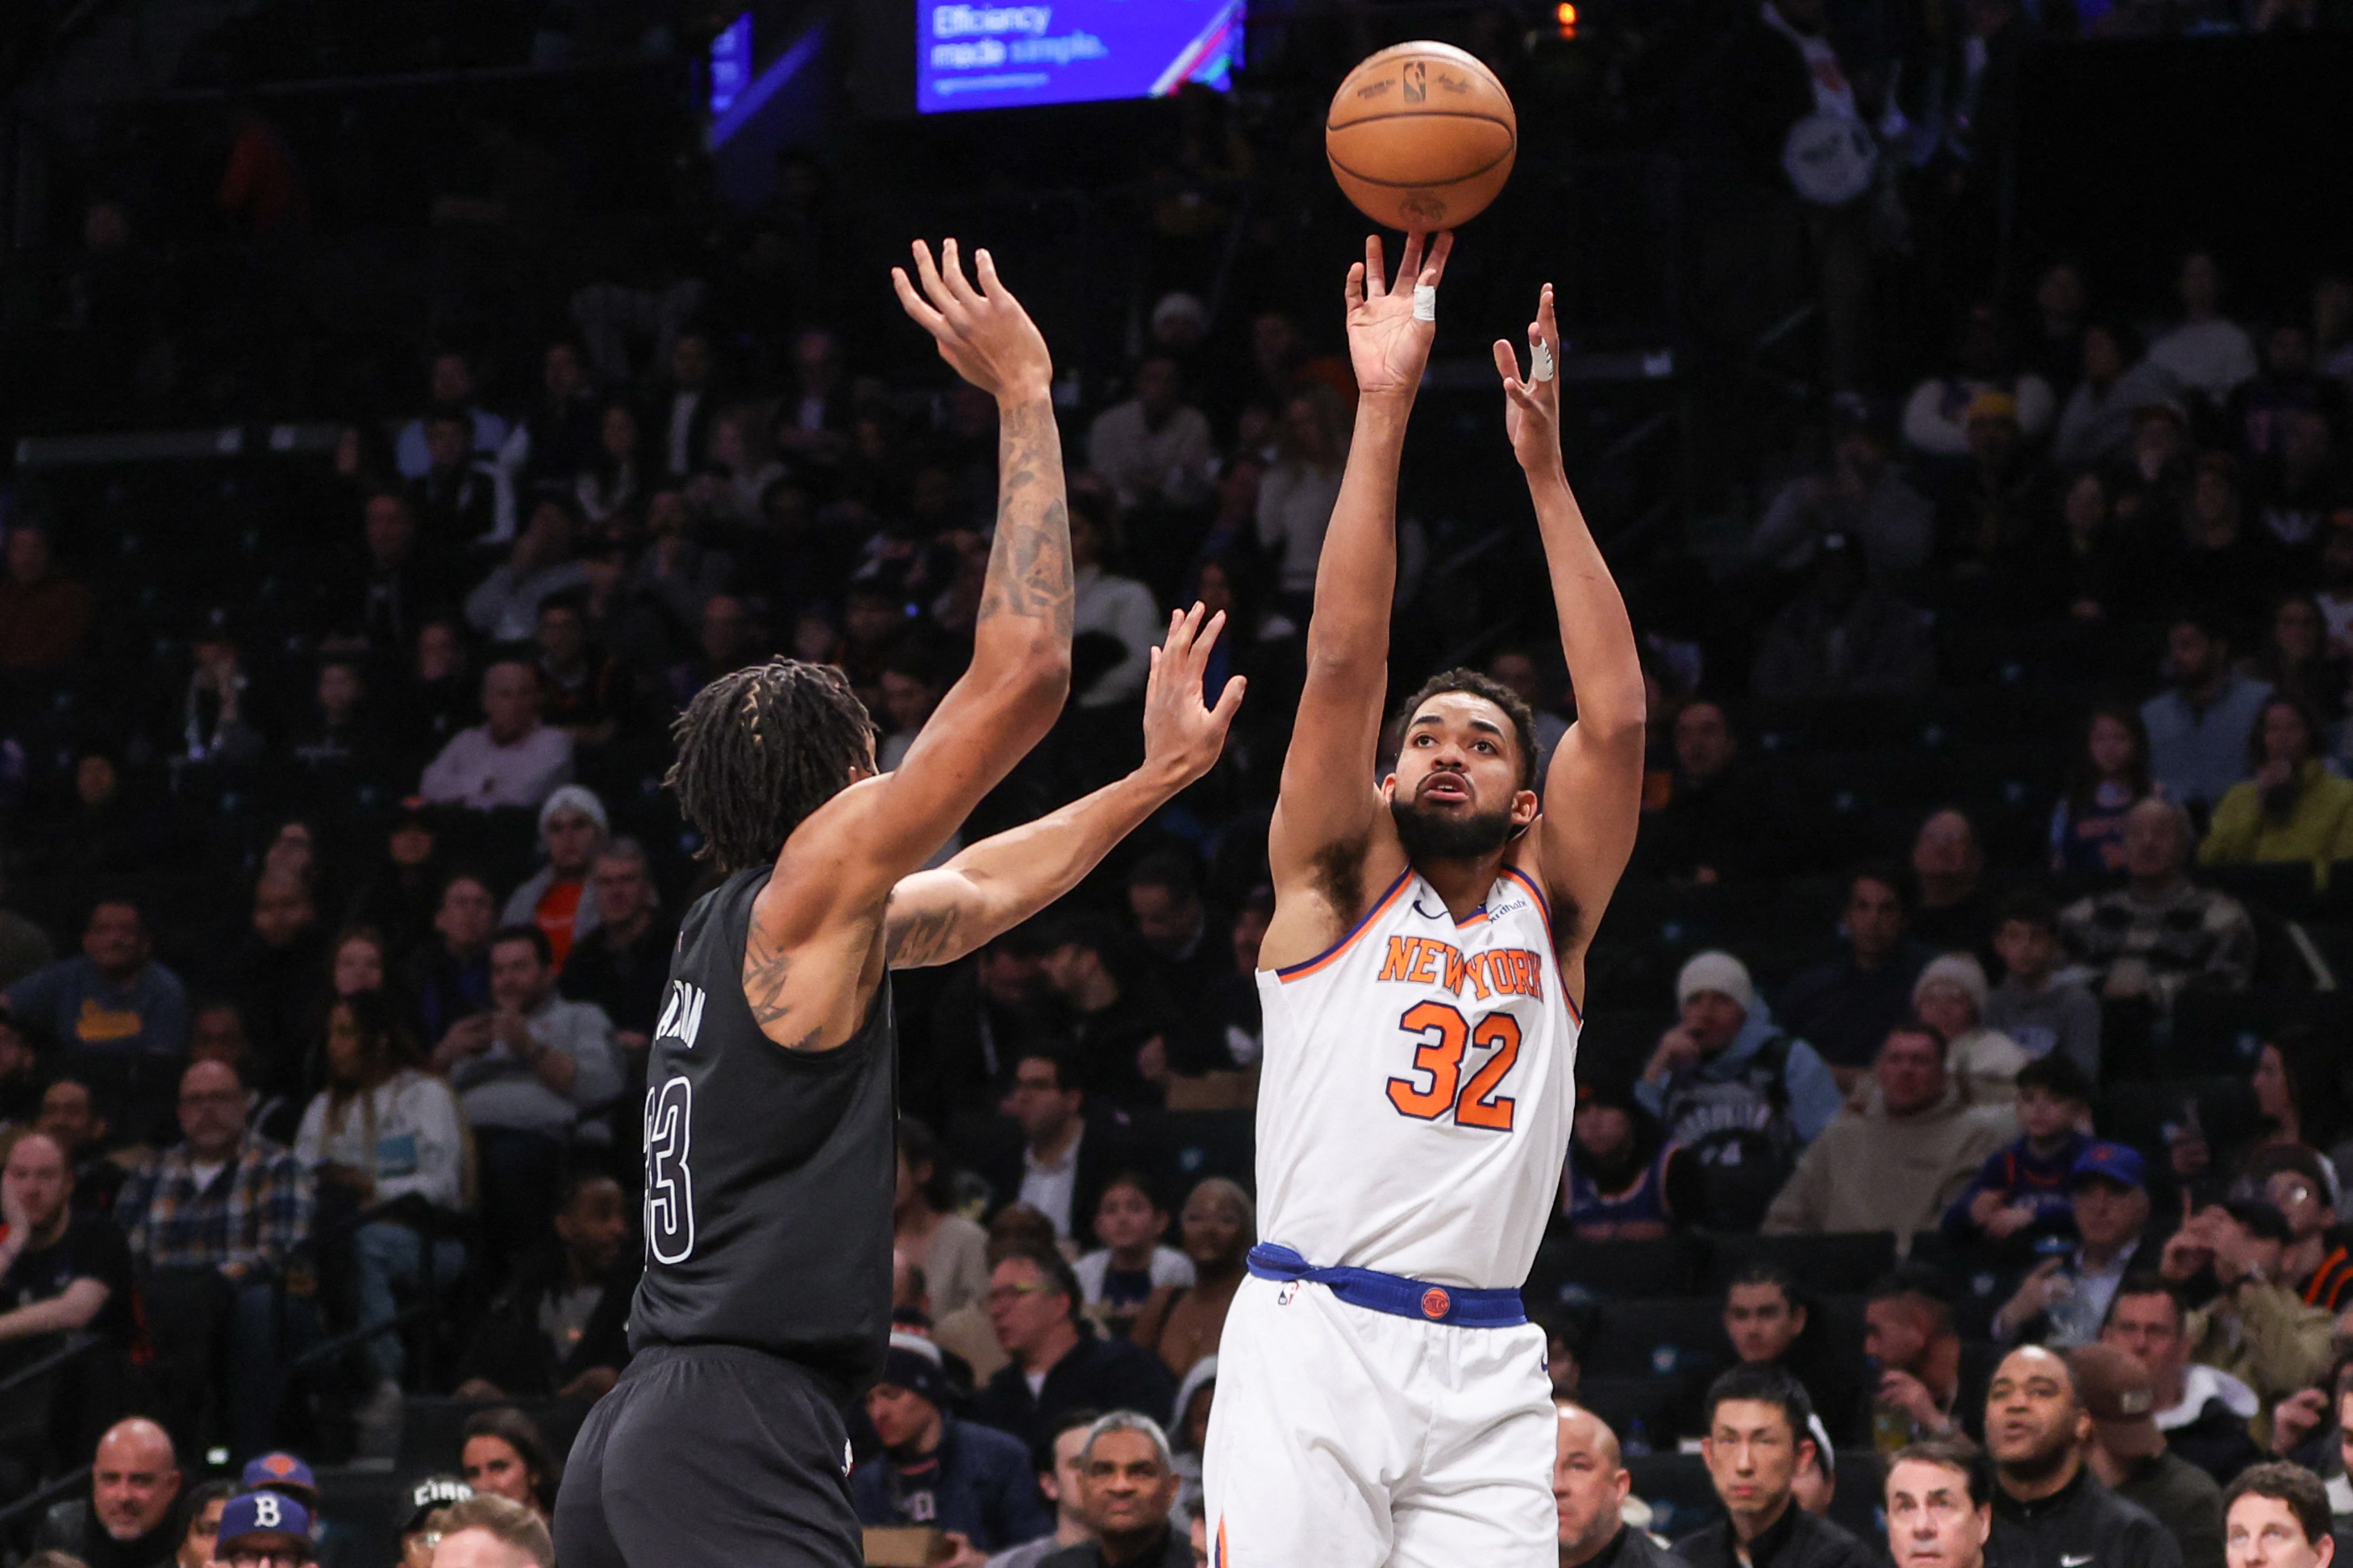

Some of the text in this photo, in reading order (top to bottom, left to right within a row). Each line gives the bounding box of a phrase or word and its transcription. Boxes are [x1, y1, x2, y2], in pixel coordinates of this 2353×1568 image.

[1377, 935, 1544, 1004] NEW YORK
[1385, 1000, 1522, 1132] 32
[254, 1495, 282, 1528] B
